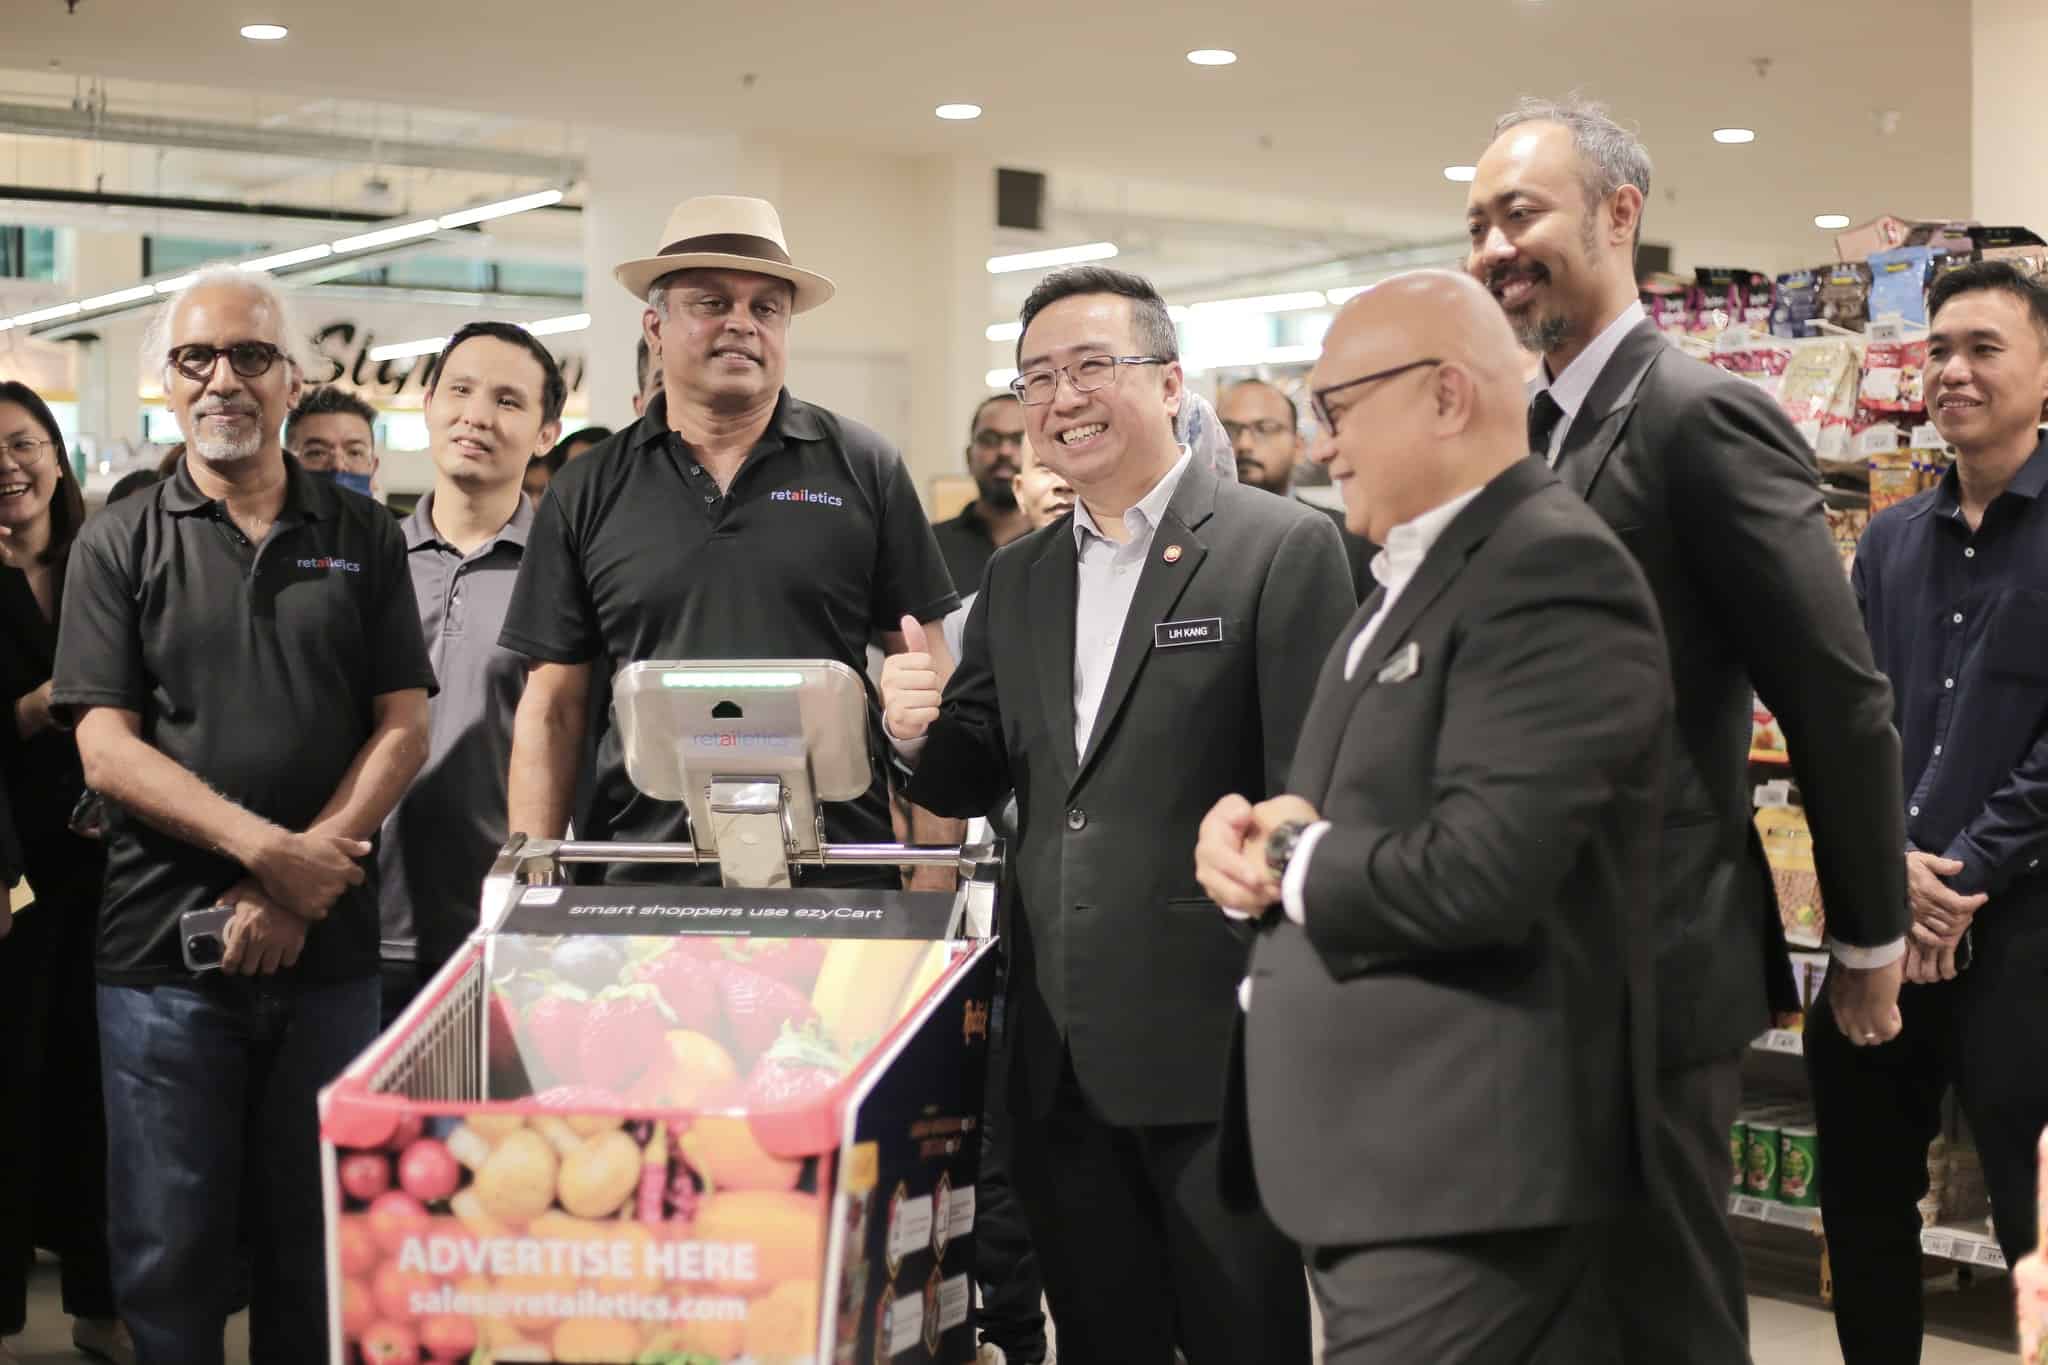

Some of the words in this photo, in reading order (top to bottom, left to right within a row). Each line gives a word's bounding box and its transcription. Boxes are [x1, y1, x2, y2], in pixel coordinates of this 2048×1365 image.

[770, 489, 843, 506] retailetics
[1169, 629, 1183, 639] LIH
[1184, 627, 1208, 637] KANG
[568, 904, 636, 915] smart
[639, 904, 744, 918] shoppers
[749, 907, 790, 917] use
[794, 907, 884, 920] ezyCart
[398, 1236, 634, 1278] ADVERTISE
[642, 1240, 758, 1281] HERE
[408, 1284, 747, 1321] sales@retailetics.com
